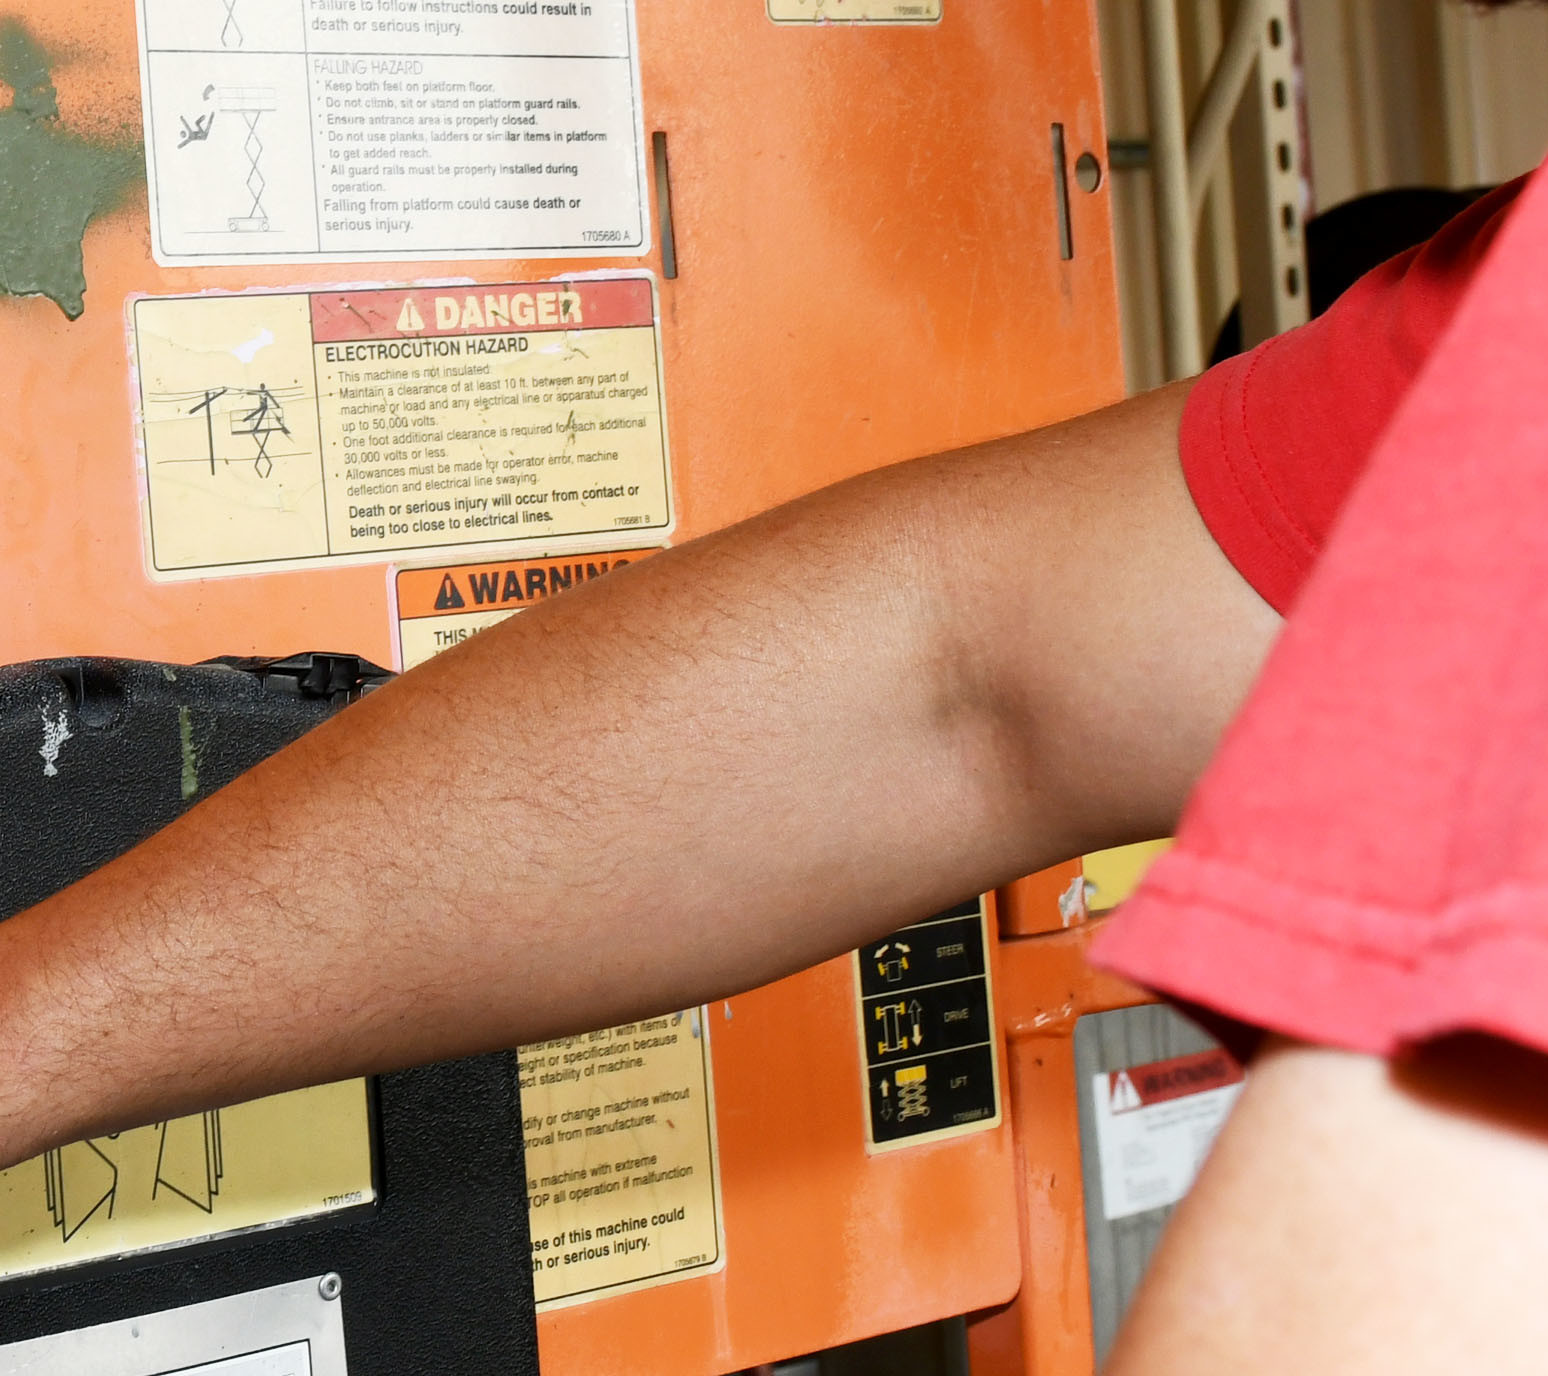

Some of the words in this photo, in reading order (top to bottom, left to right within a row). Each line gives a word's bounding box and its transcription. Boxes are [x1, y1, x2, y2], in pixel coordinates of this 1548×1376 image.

[324, 198, 366, 215] Falling
[370, 198, 398, 211] from
[403, 198, 453, 212] platform
[457, 197, 490, 210] could
[494, 199, 529, 209] cause
[532, 196, 565, 209] death
[568, 198, 581, 209] or
[436, 292, 583, 330] DANGER
[325, 340, 460, 363] ELECTROCUTION
[465, 336, 528, 355] HAZARD
[348, 503, 385, 519] Death
[388, 504, 402, 516] or
[405, 500, 451, 514] serious
[454, 497, 488, 513] injury
[491, 493, 512, 507] will
[514, 493, 548, 505] occur
[551, 489, 579, 502] from
[581, 485, 625, 502] contact
[627, 485, 639, 496] or
[350, 523, 385, 539] being
[388, 522, 409, 534] too
[412, 519, 445, 533] close
[448, 517, 461, 529] to
[464, 511, 519, 528] electrical
[522, 510, 553, 523] lines.
[936, 944, 964, 958] STEER
[944, 1008, 969, 1022] DRIVE
[950, 1076, 968, 1088] LIFT
[553, 1233, 566, 1247] of
[568, 1228, 592, 1244] this
[595, 1218, 648, 1238] machine
[651, 1206, 685, 1226] could
[547, 1257, 560, 1269] or
[564, 1245, 610, 1264] serious
[613, 1236, 650, 1255] injury.
